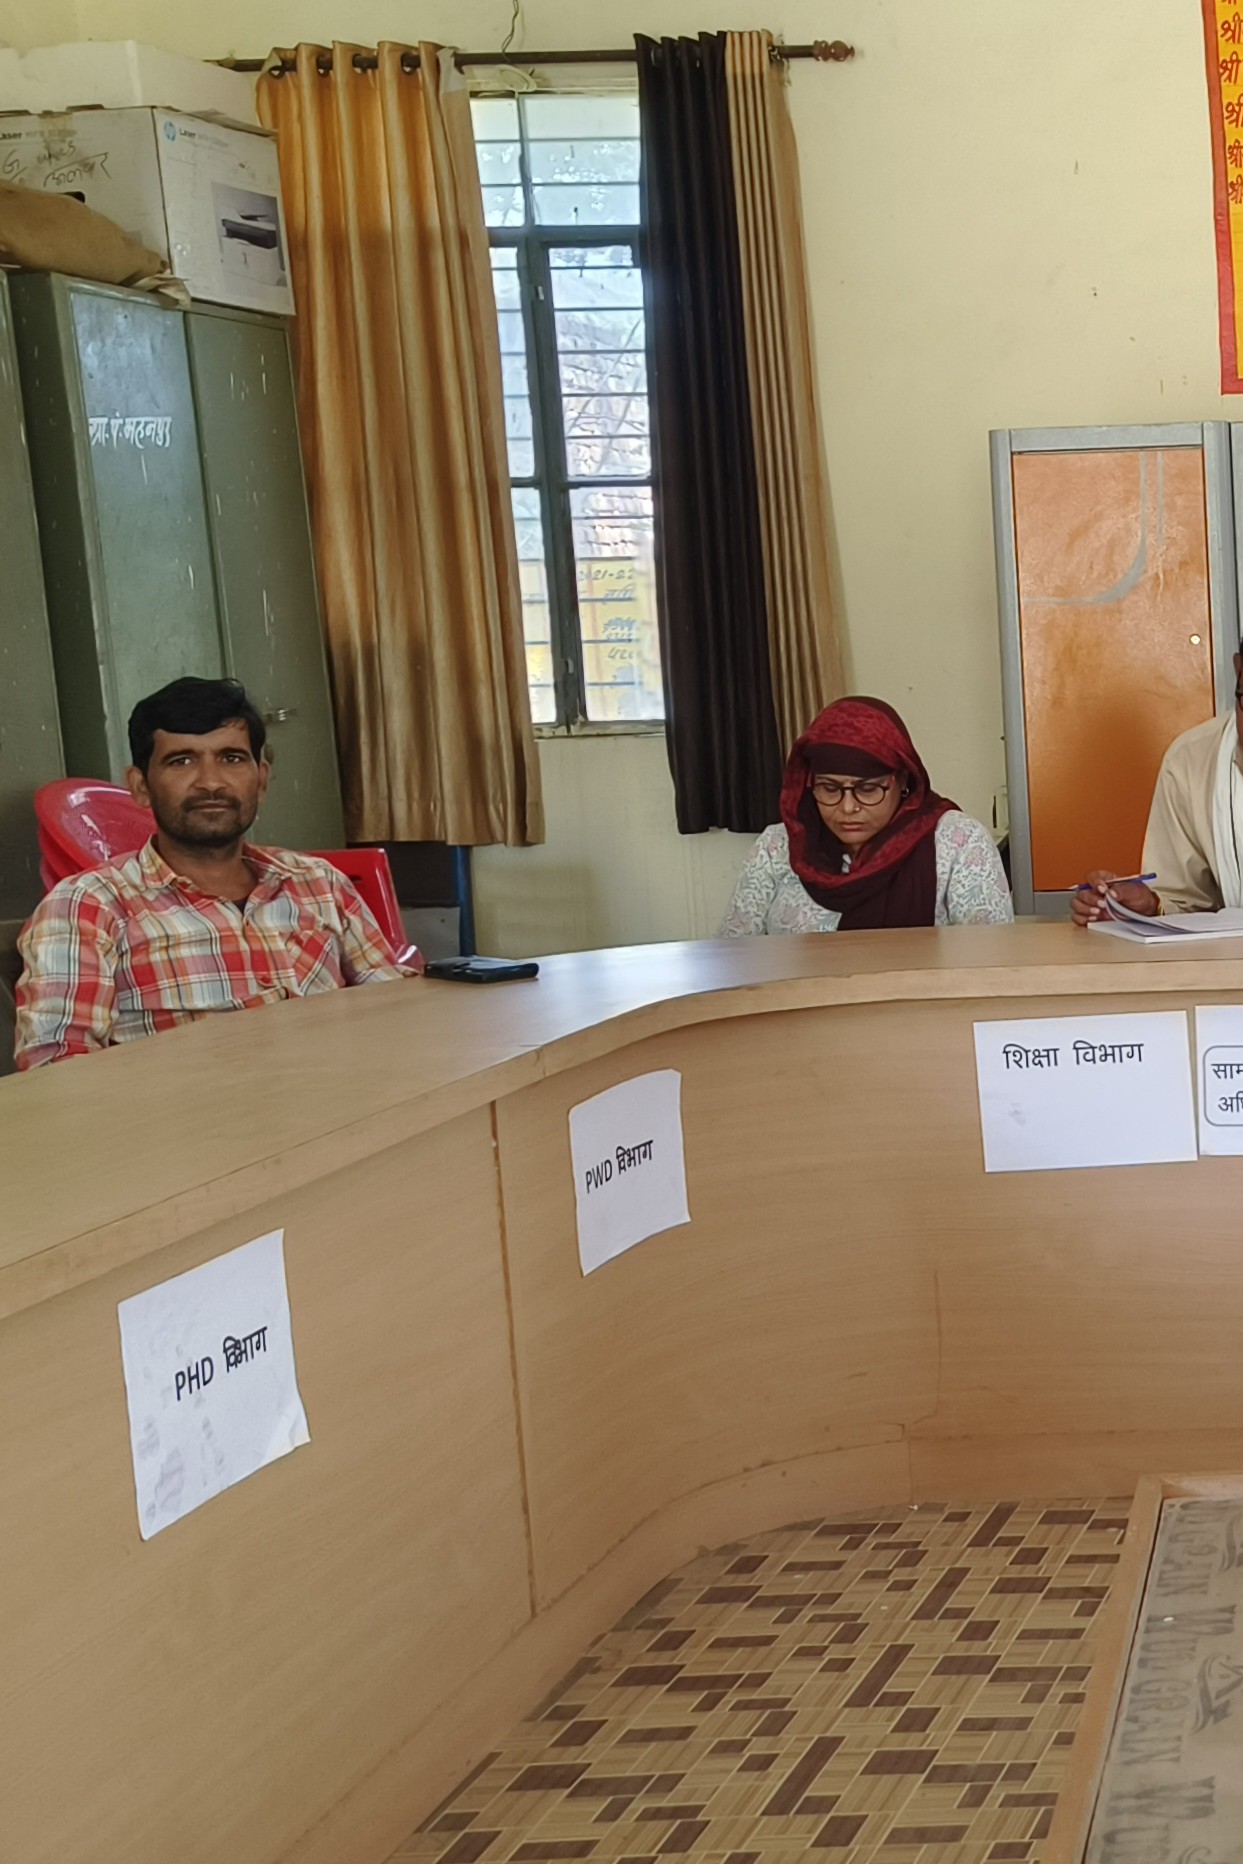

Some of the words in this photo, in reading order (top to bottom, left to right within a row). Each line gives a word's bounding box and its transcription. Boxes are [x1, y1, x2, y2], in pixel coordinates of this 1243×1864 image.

[1219, 51, 1241, 85] श्री
[1003, 1043, 1059, 1069] शिक्षा
[1074, 1040, 1145, 1067] विभाग
[585, 1159, 613, 1194] PWD
[616, 1140, 654, 1175] विभाग
[175, 1356, 214, 1402] PHD
[223, 1326, 268, 1373] विभाग
